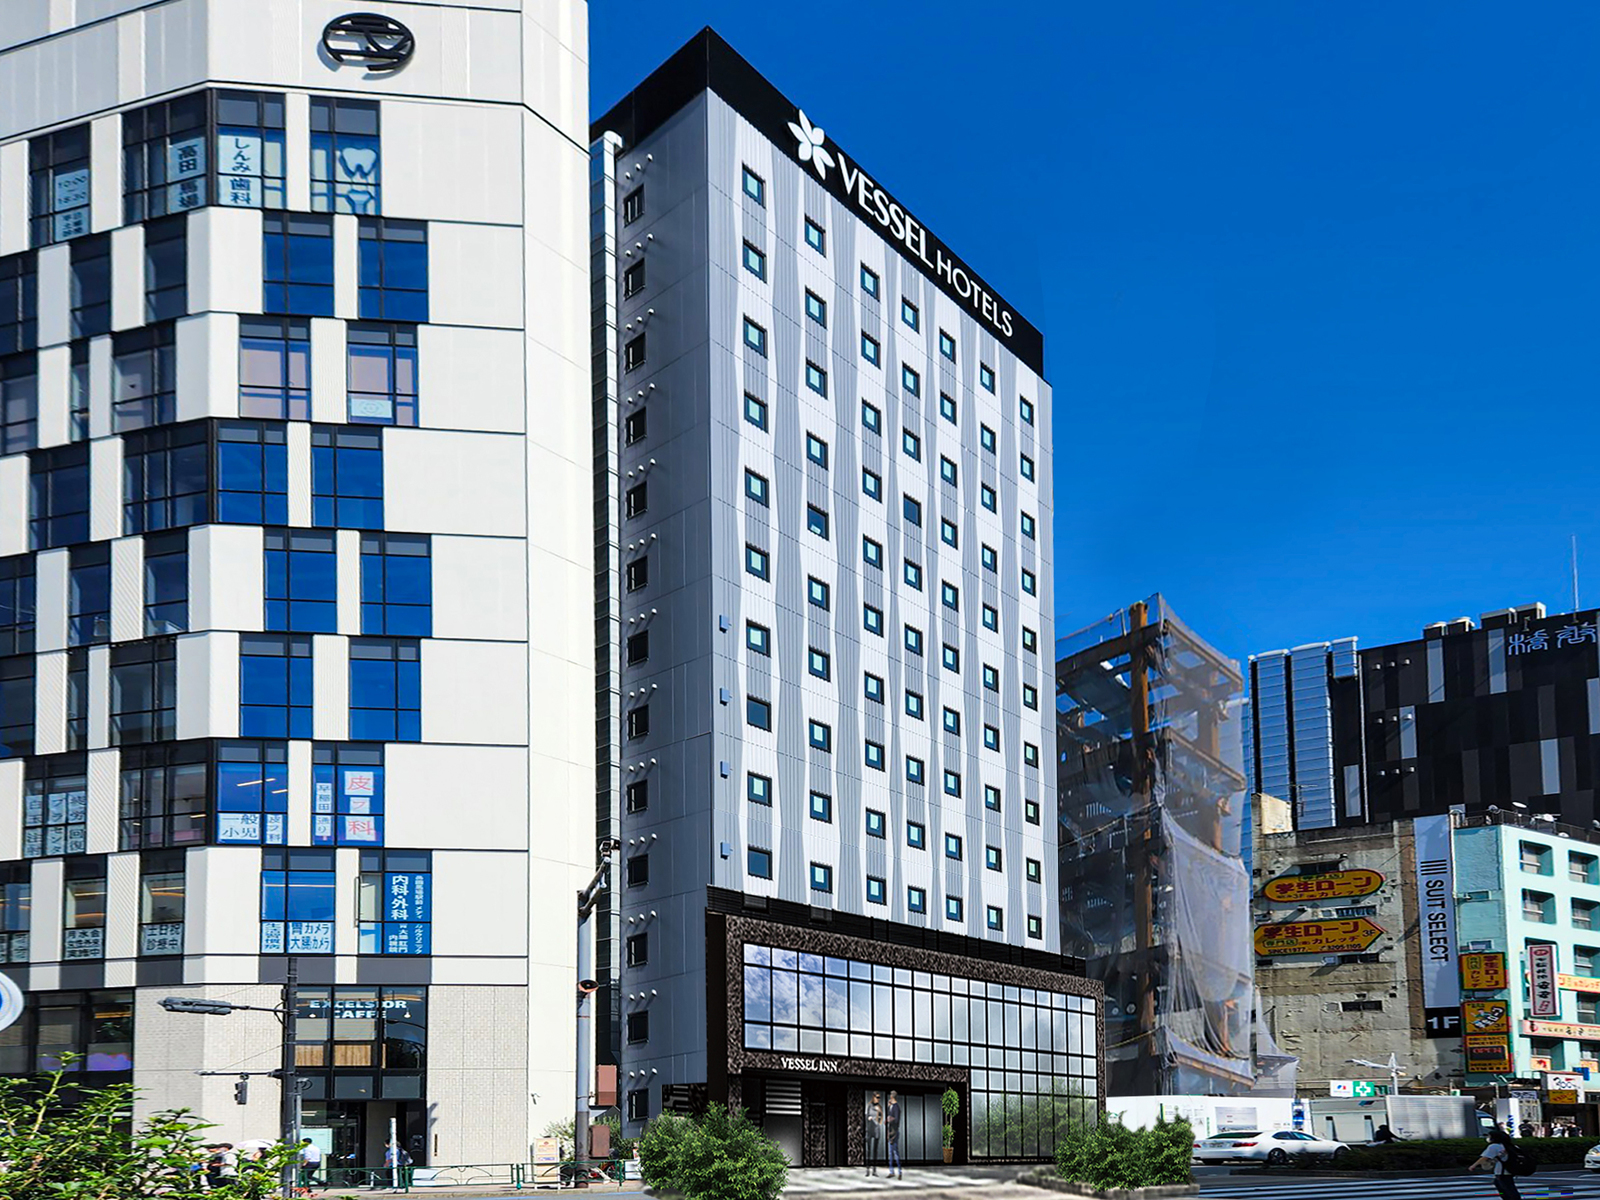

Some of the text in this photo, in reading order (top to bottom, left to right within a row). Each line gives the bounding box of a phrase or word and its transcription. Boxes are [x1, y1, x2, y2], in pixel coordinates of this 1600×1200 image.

[229, 138, 252, 205] しんみ歯科
[837, 152, 1013, 338] VESSEL HOTELS
[347, 776, 374, 836] 皮フ科
[221, 813, 259, 825] 一般
[221, 827, 258, 839] 小児
[1275, 876, 1372, 895] 学生ローン
[1425, 879, 1449, 962] SUIT SELECT
[1263, 921, 1360, 939] 学生ローン
[1362, 928, 1376, 938] 3F
[1427, 1016, 1460, 1030] 1F
[781, 1057, 838, 1073] VESSEL INN
